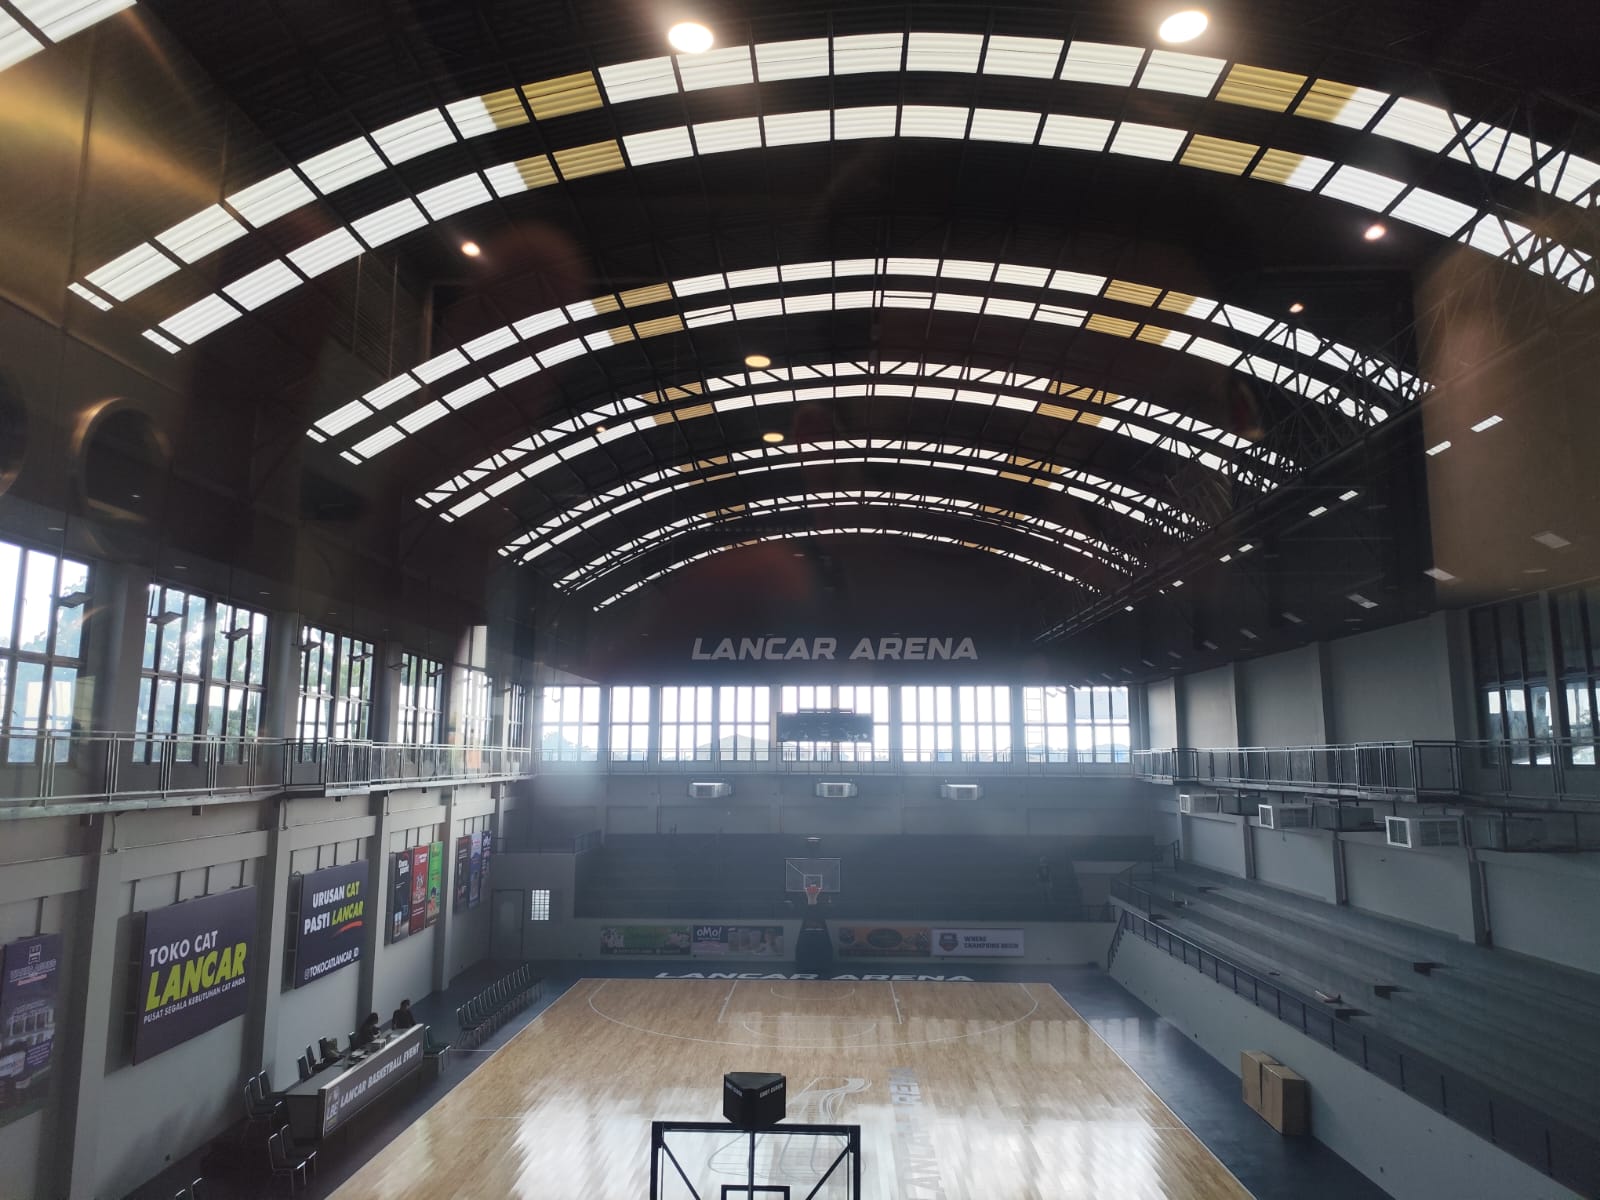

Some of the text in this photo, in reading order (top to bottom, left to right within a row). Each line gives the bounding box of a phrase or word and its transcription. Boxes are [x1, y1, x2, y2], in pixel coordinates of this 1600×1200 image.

[691, 637, 978, 660] LANCAR ARENA
[312, 881, 360, 908] URUSAN CAT
[304, 900, 364, 935] PASTI LANCAR
[150, 930, 218, 967] TOKO CAT
[145, 942, 247, 1012] LANCAR
[655, 972, 820, 980] LANCAR
[143, 1009, 163, 1024] PUSAT
[164, 1001, 187, 1016] SEGALA
[188, 986, 221, 1007] KEBUTUHAN
[221, 983, 232, 994] CAT
[340, 1042, 420, 1108] LANCAR BASKETBALL EVENT
